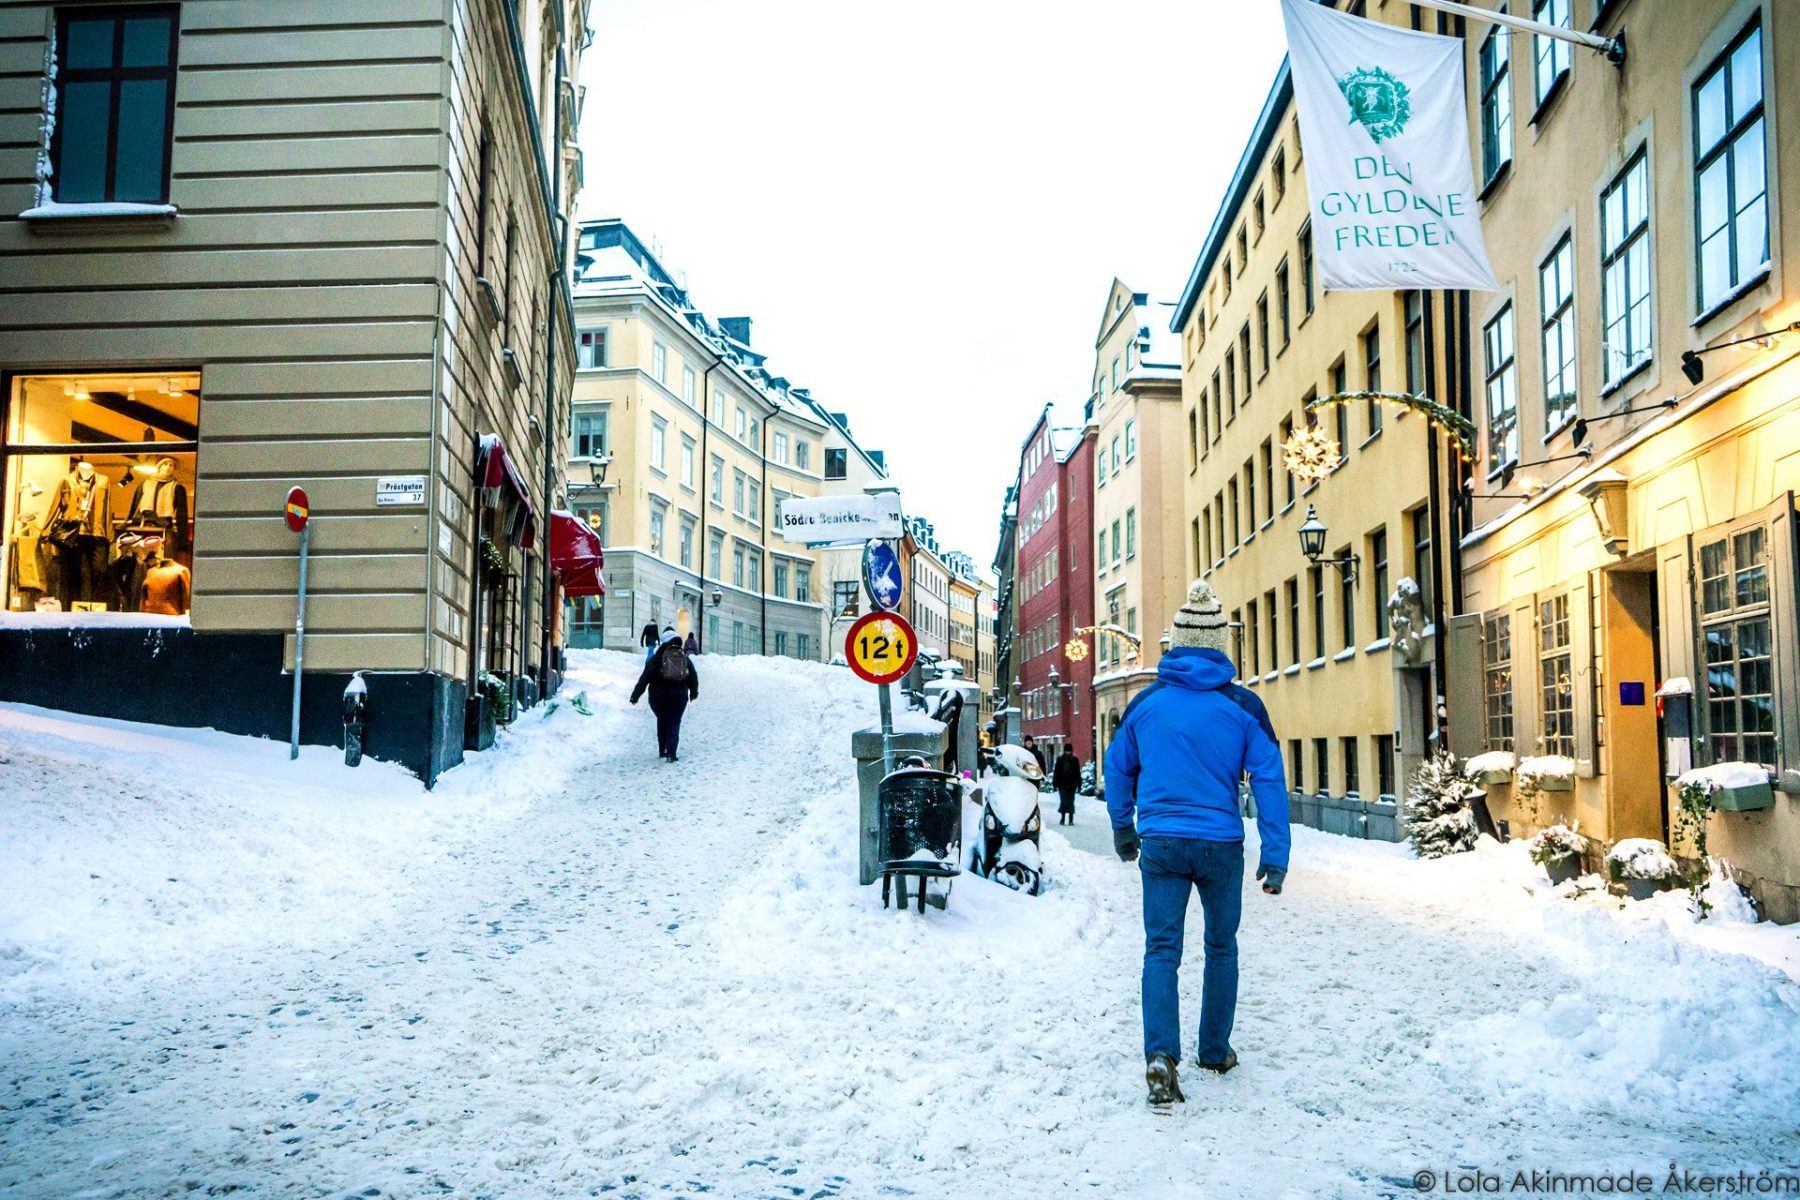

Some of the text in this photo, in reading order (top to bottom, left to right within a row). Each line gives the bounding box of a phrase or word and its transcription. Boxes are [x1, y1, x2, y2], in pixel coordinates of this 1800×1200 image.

[1354, 155, 1413, 185] DEN
[386, 482, 423, 492] Prästgatan
[412, 493, 422, 501] 37
